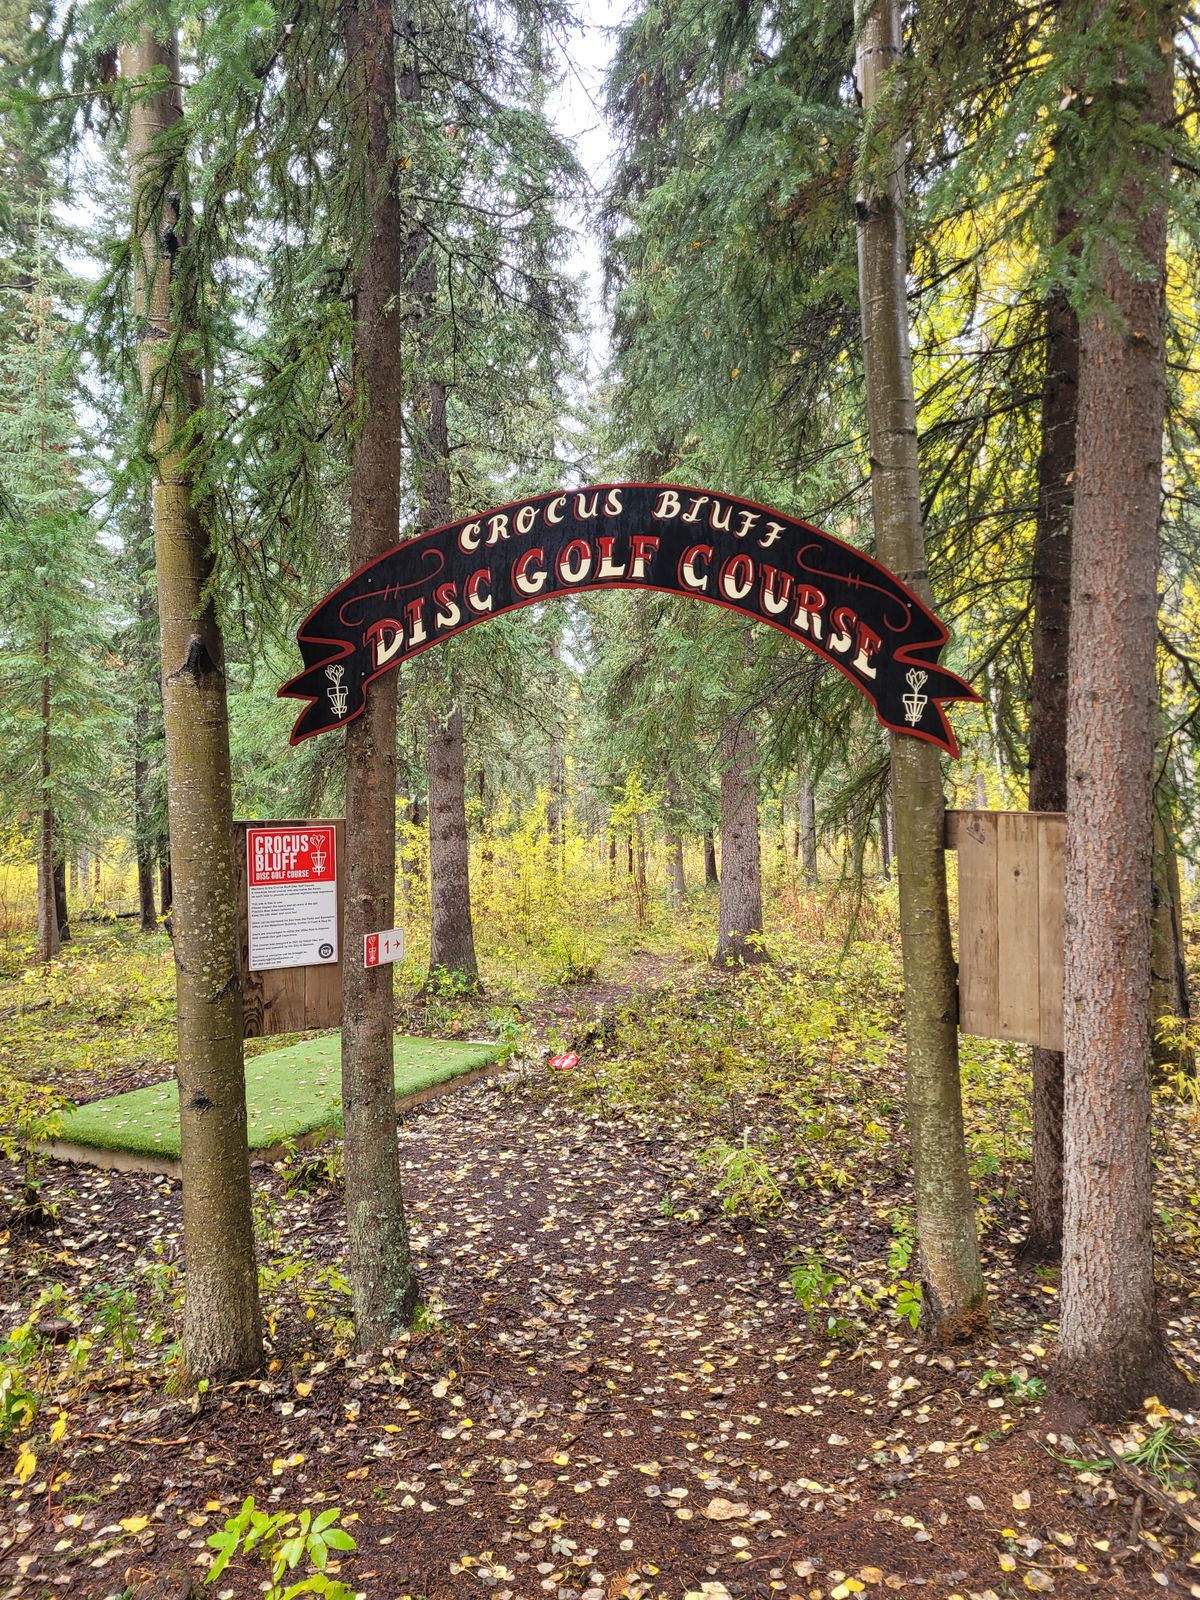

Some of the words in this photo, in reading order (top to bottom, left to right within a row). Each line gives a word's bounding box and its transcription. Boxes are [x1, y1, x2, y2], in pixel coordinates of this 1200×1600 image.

[363, 567, 494, 671] DISC
[511, 535, 661, 598] GOLF
[678, 544, 884, 681] COURSE
[255, 834, 309, 855] CROCUS
[255, 852, 298, 872] BLUFF
[255, 871, 270, 880] DISC
[271, 870, 286, 880] GOLF
[286, 869, 309, 879] COURSE
[384, 939, 389, 954] 1
